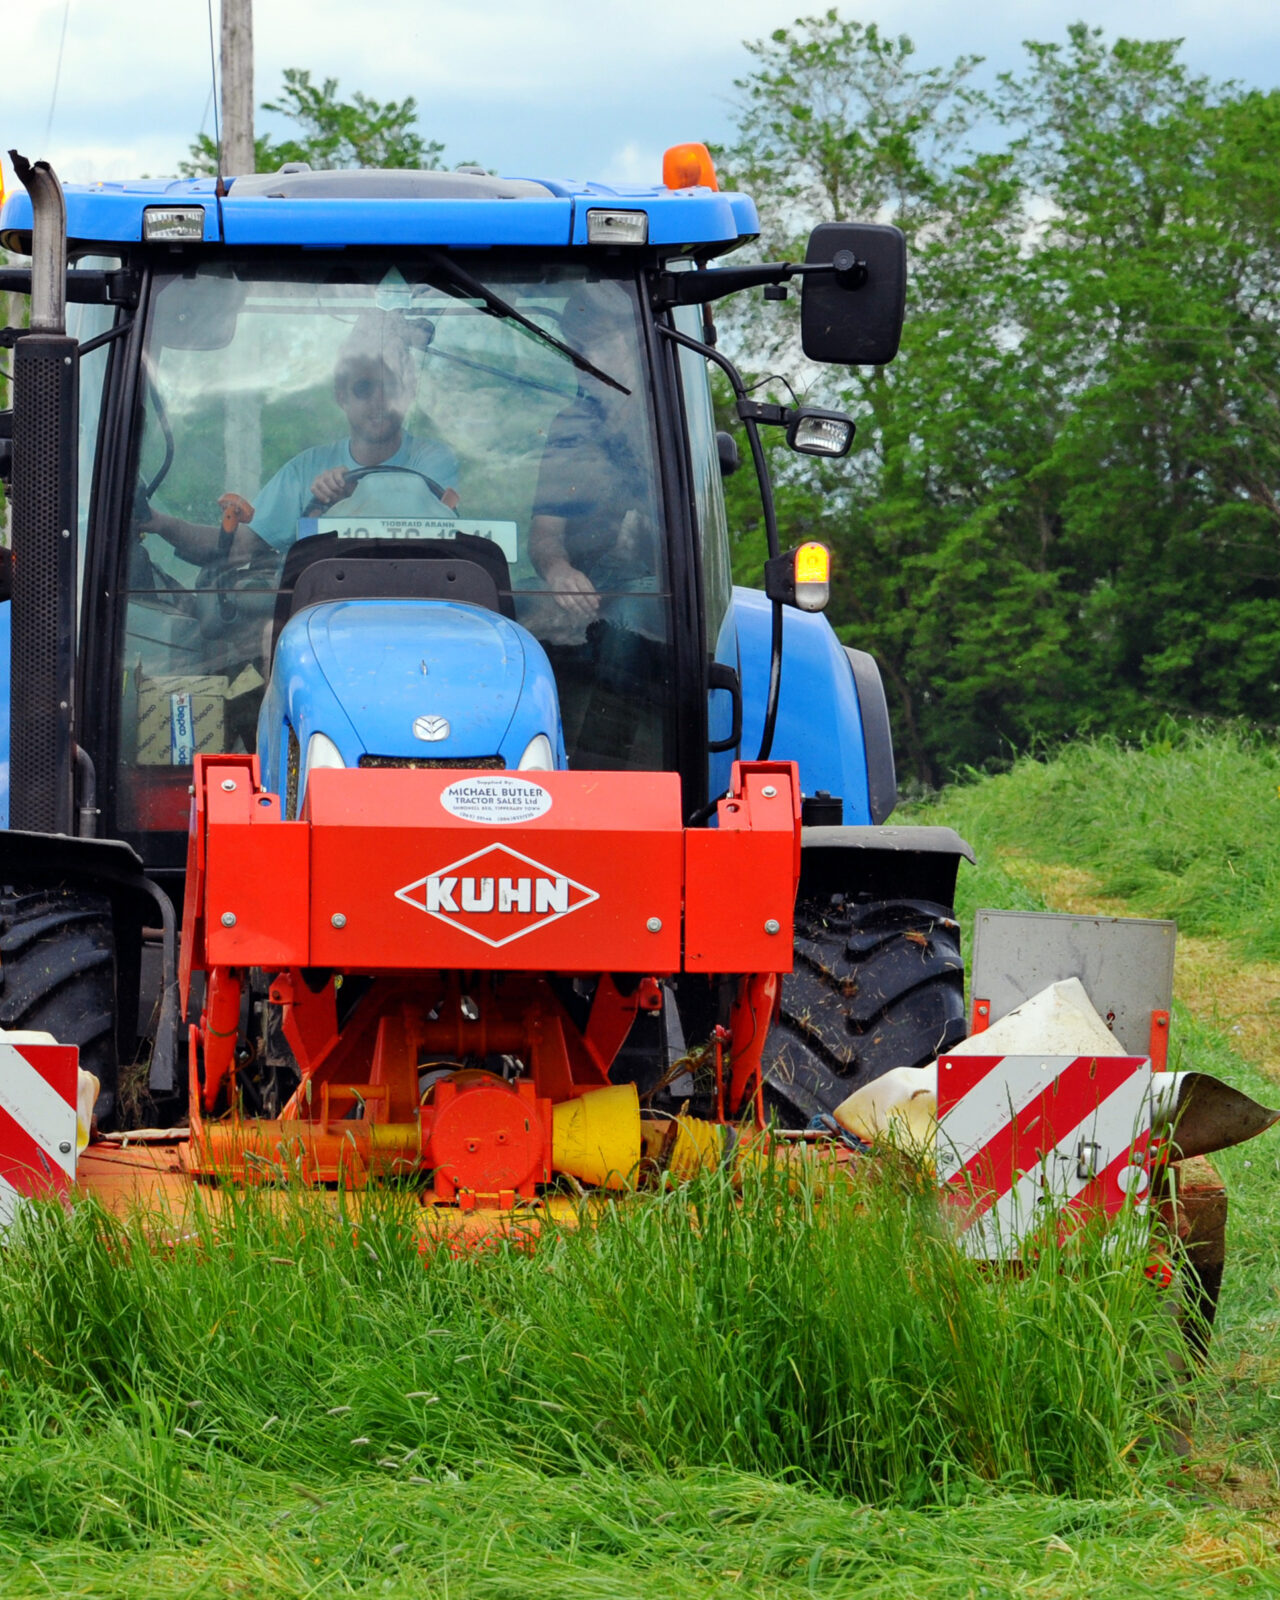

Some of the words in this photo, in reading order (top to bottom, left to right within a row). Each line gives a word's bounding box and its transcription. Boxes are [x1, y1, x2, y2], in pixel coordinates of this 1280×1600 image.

[176, 705, 187, 736] bepco
[449, 787, 498, 797] MICHAEL
[501, 788, 543, 797] BUTLER
[455, 797, 494, 805] TRACTOR
[496, 797, 522, 805] SALES
[425, 876, 569, 913] KUHN
